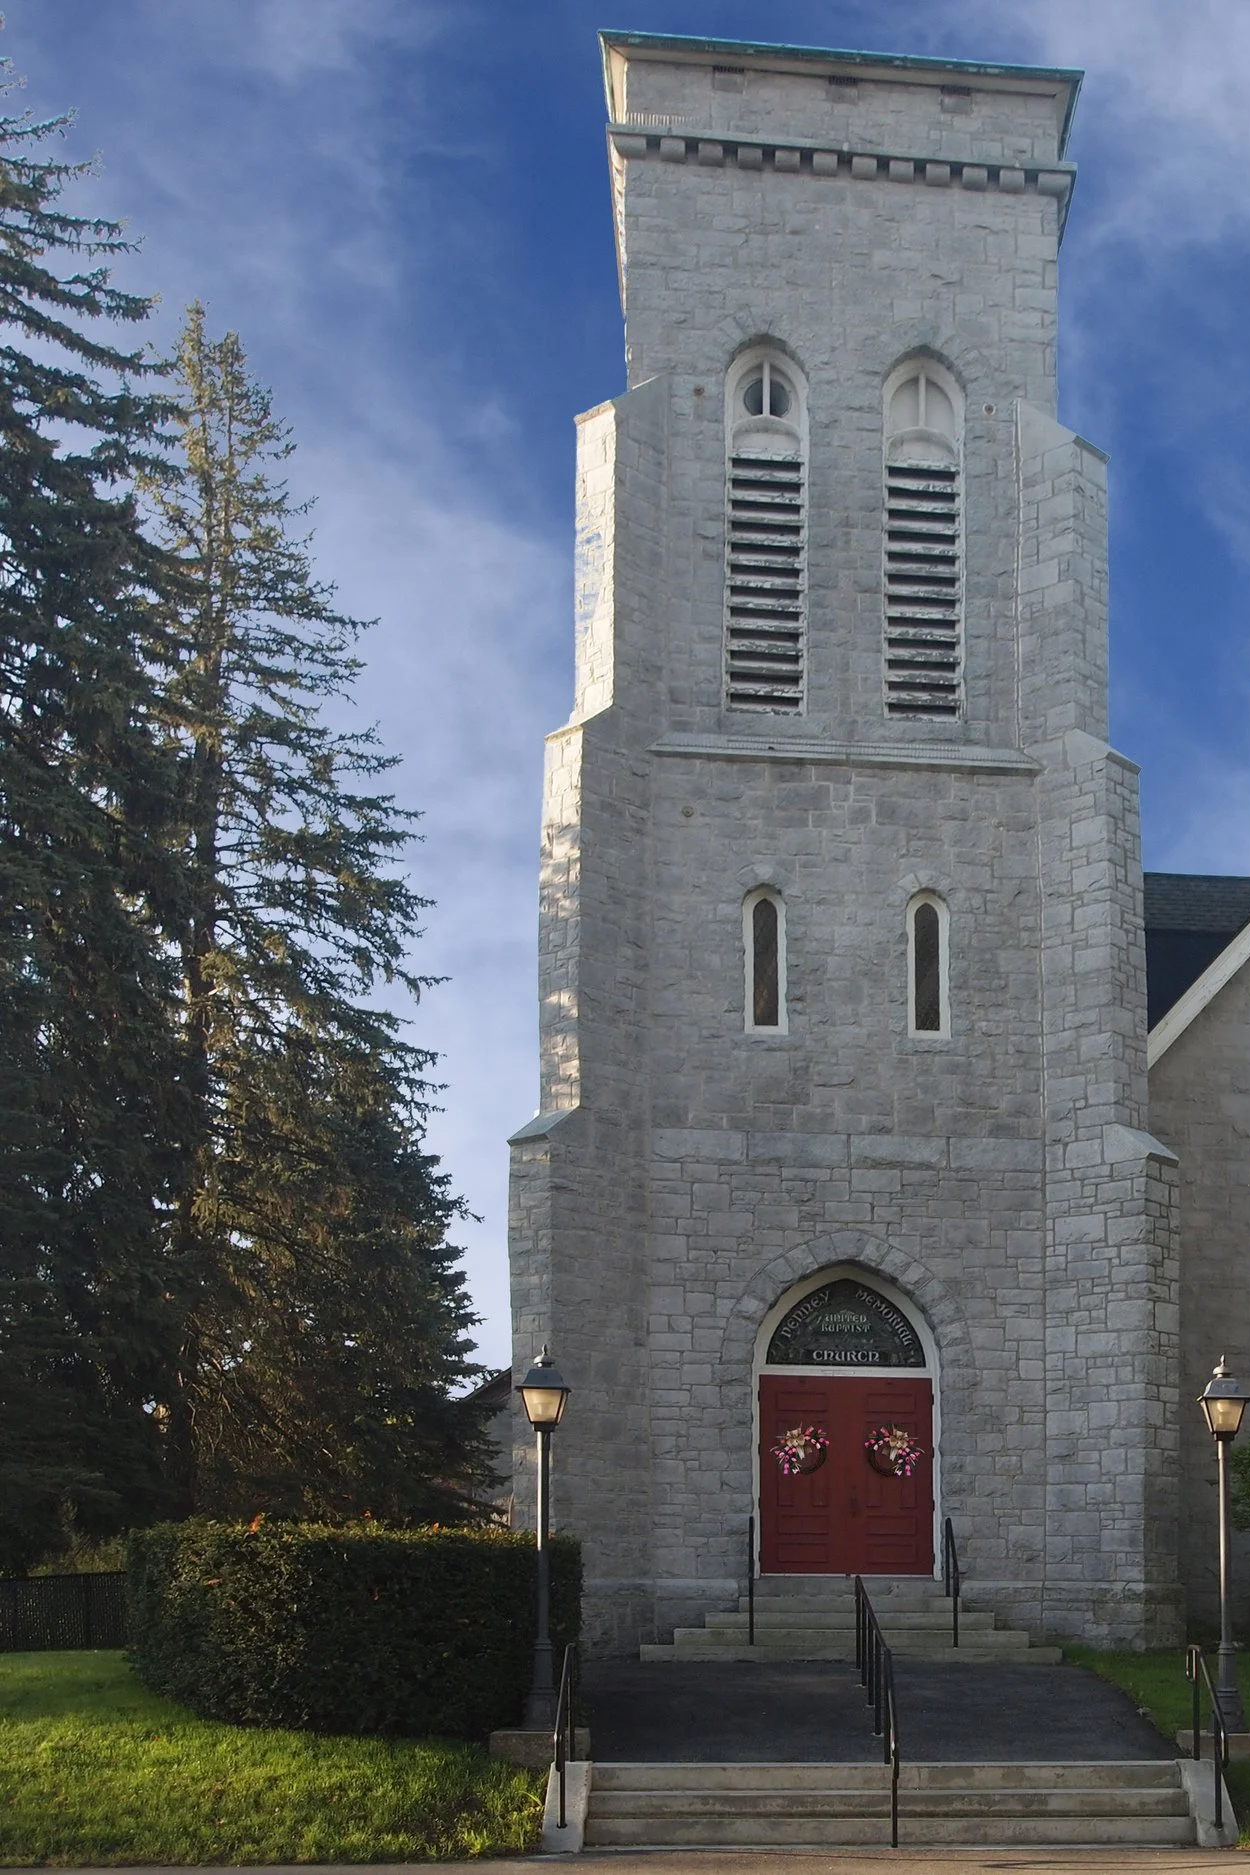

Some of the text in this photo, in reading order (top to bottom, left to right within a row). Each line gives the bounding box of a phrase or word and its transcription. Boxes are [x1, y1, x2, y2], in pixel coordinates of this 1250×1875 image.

[824, 1313, 867, 1323] UNITED
[855, 1288, 914, 1346] MEMORIAL
[812, 1350, 880, 1362] CHURCH
